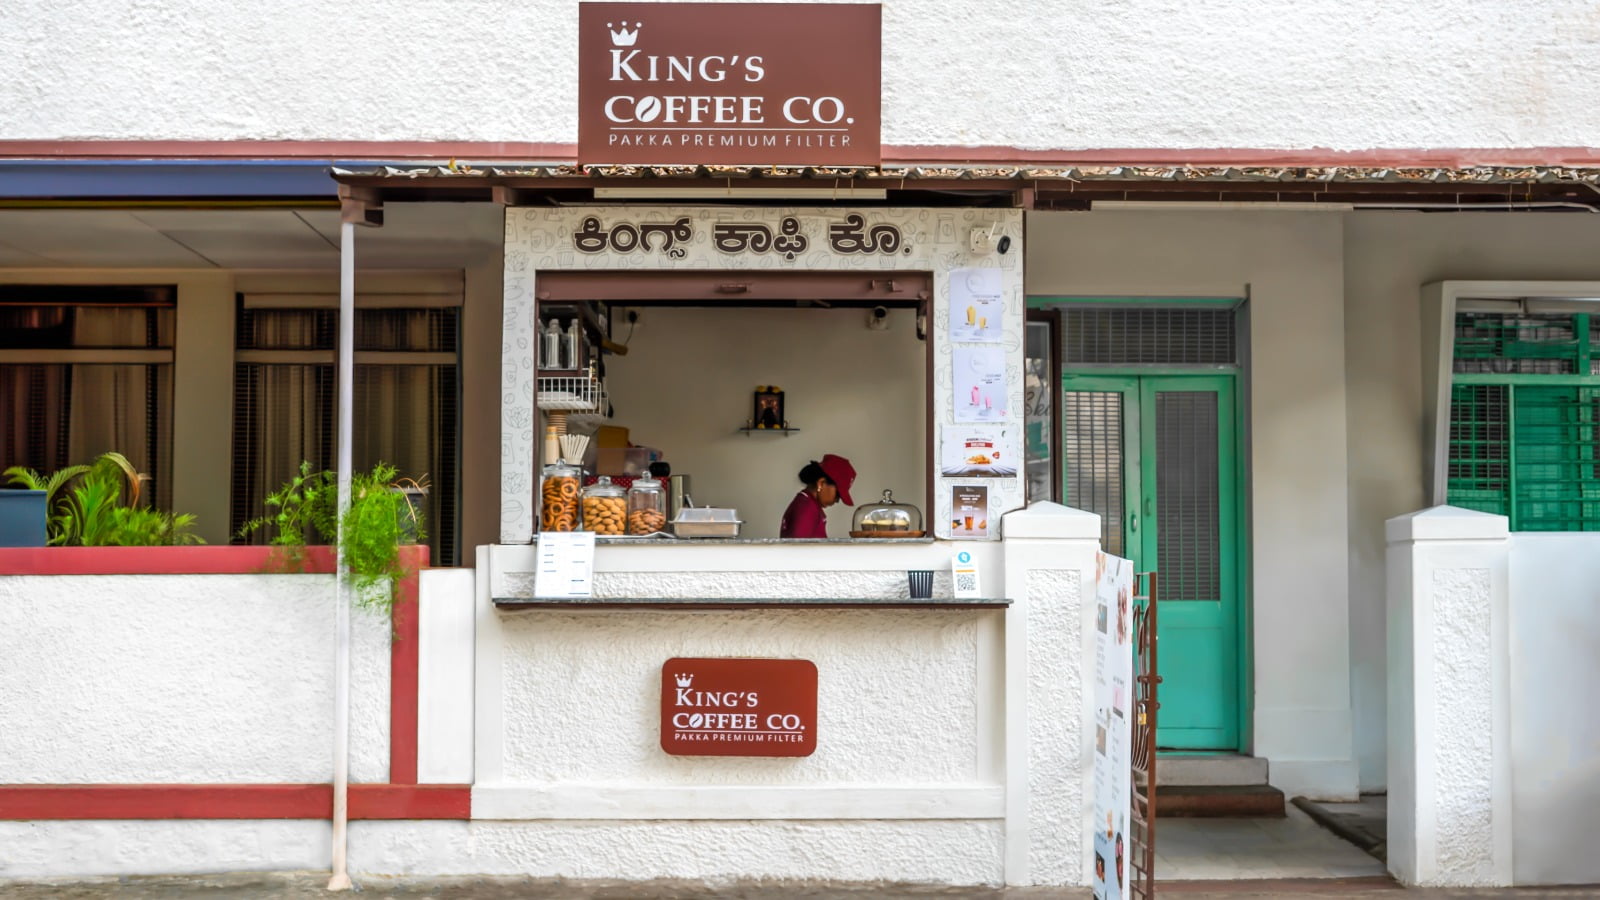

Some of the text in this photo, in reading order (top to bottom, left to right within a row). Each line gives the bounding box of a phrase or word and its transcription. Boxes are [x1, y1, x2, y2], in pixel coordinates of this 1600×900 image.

[608, 49, 765, 82] KING'S
[604, 95, 855, 125] COFFEE CO.
[609, 134, 851, 148] PAKKA PREMIUM FILTER
[674, 688, 759, 708] KING'S
[672, 712, 806, 730] COFFEE CO.
[674, 733, 804, 743] PAKKA PREMIUM FILTER
